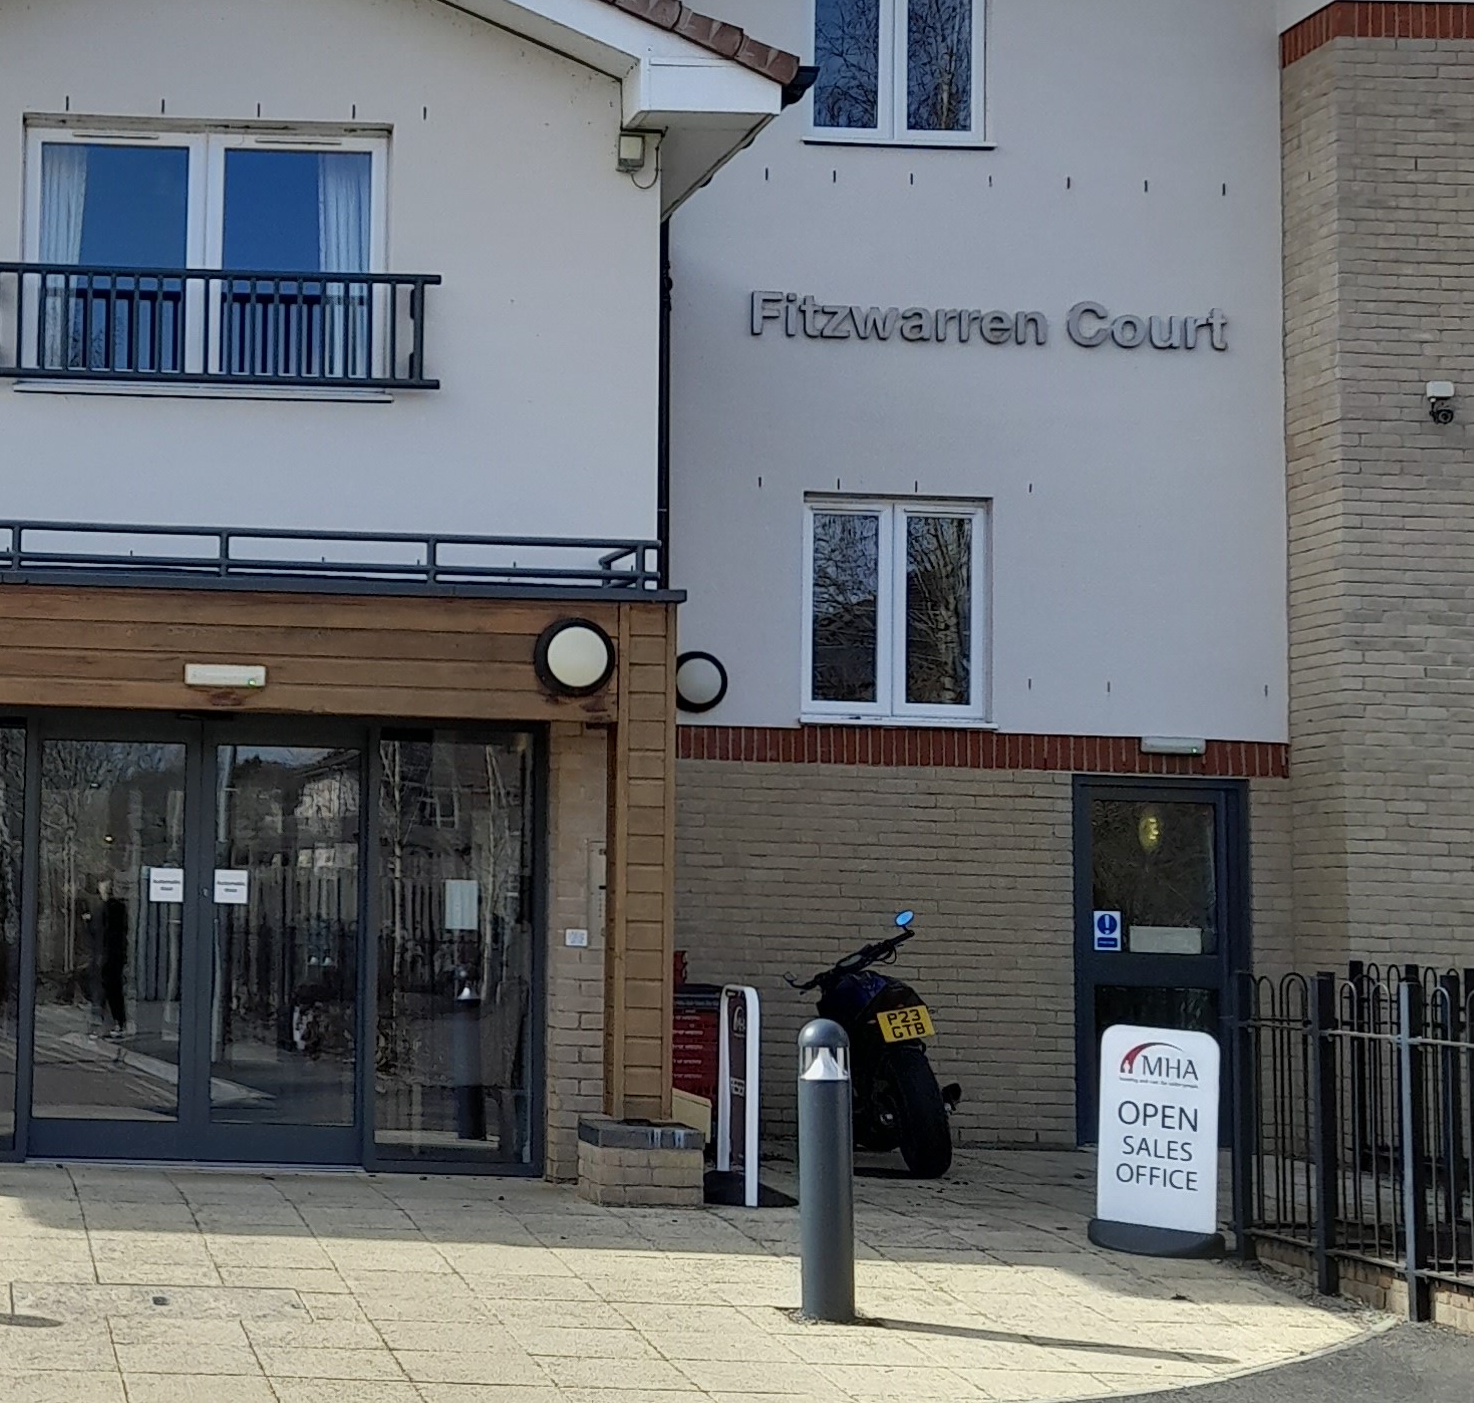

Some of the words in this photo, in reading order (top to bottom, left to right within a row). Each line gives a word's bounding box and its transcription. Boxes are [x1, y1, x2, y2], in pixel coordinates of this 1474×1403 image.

[750, 290, 1048, 346] Fitzwarren
[1066, 301, 1230, 351] Court
[886, 1008, 922, 1026] P23
[891, 1022, 926, 1039] GTB
[1141, 1054, 1199, 1082] MHA
[1117, 1100, 1199, 1132] OPEN
[1122, 1135, 1193, 1162] SALES
[1116, 1162, 1199, 1192] OFFICE
